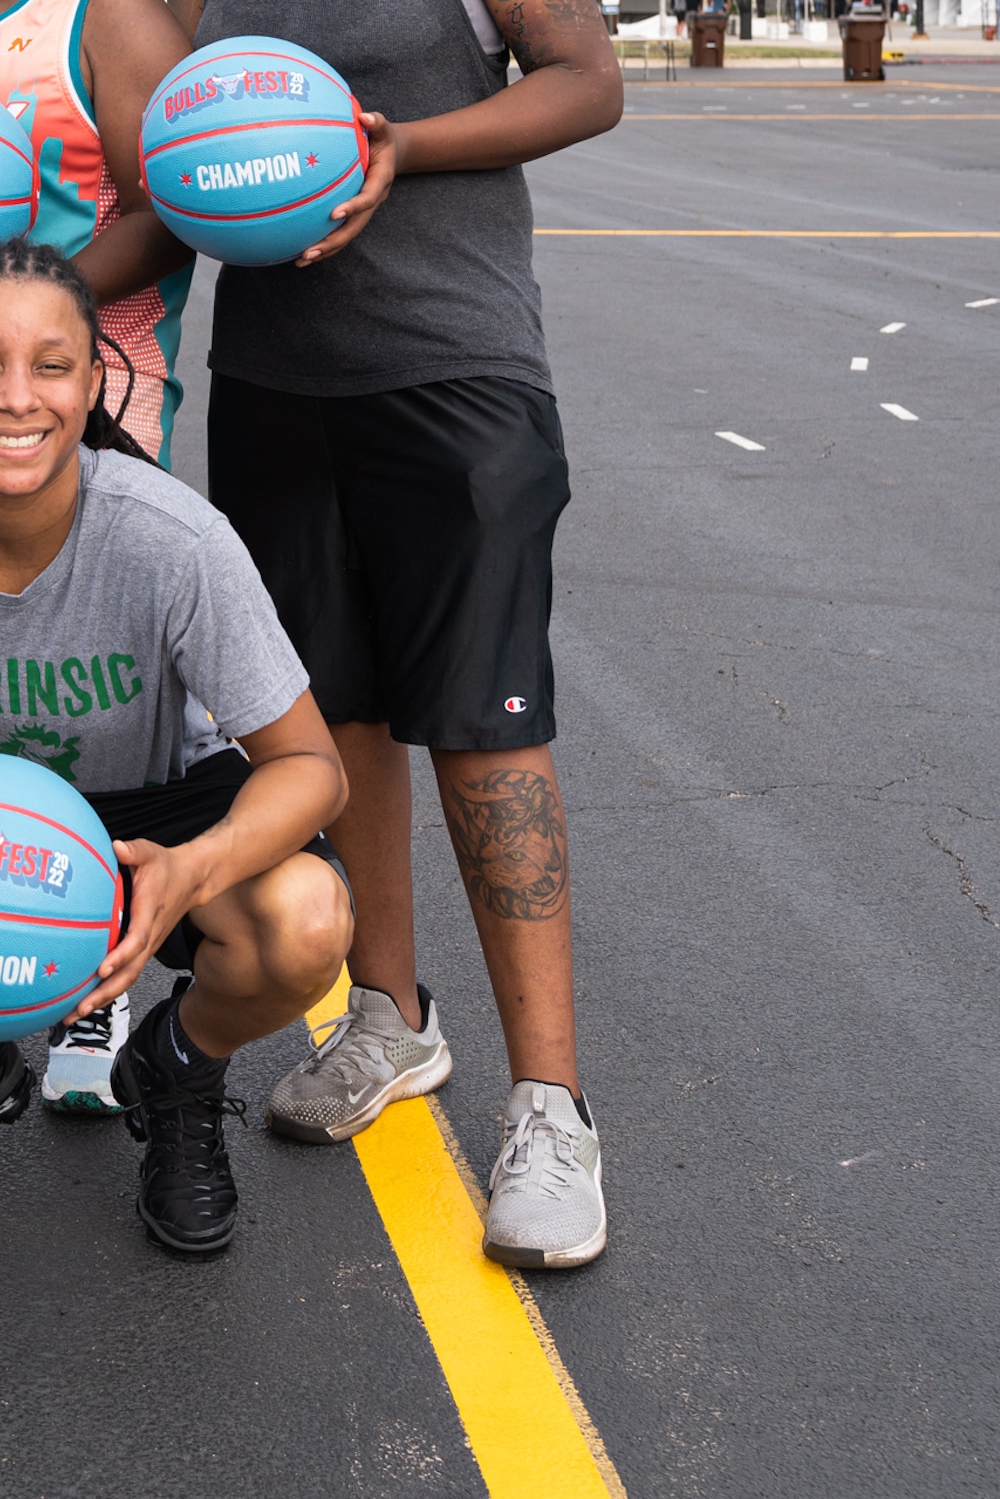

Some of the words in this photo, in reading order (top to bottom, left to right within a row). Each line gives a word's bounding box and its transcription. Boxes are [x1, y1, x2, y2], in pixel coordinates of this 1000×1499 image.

[164, 79, 218, 119] BULLS
[243, 71, 289, 93] FEST
[196, 151, 301, 190] CHAMPION
